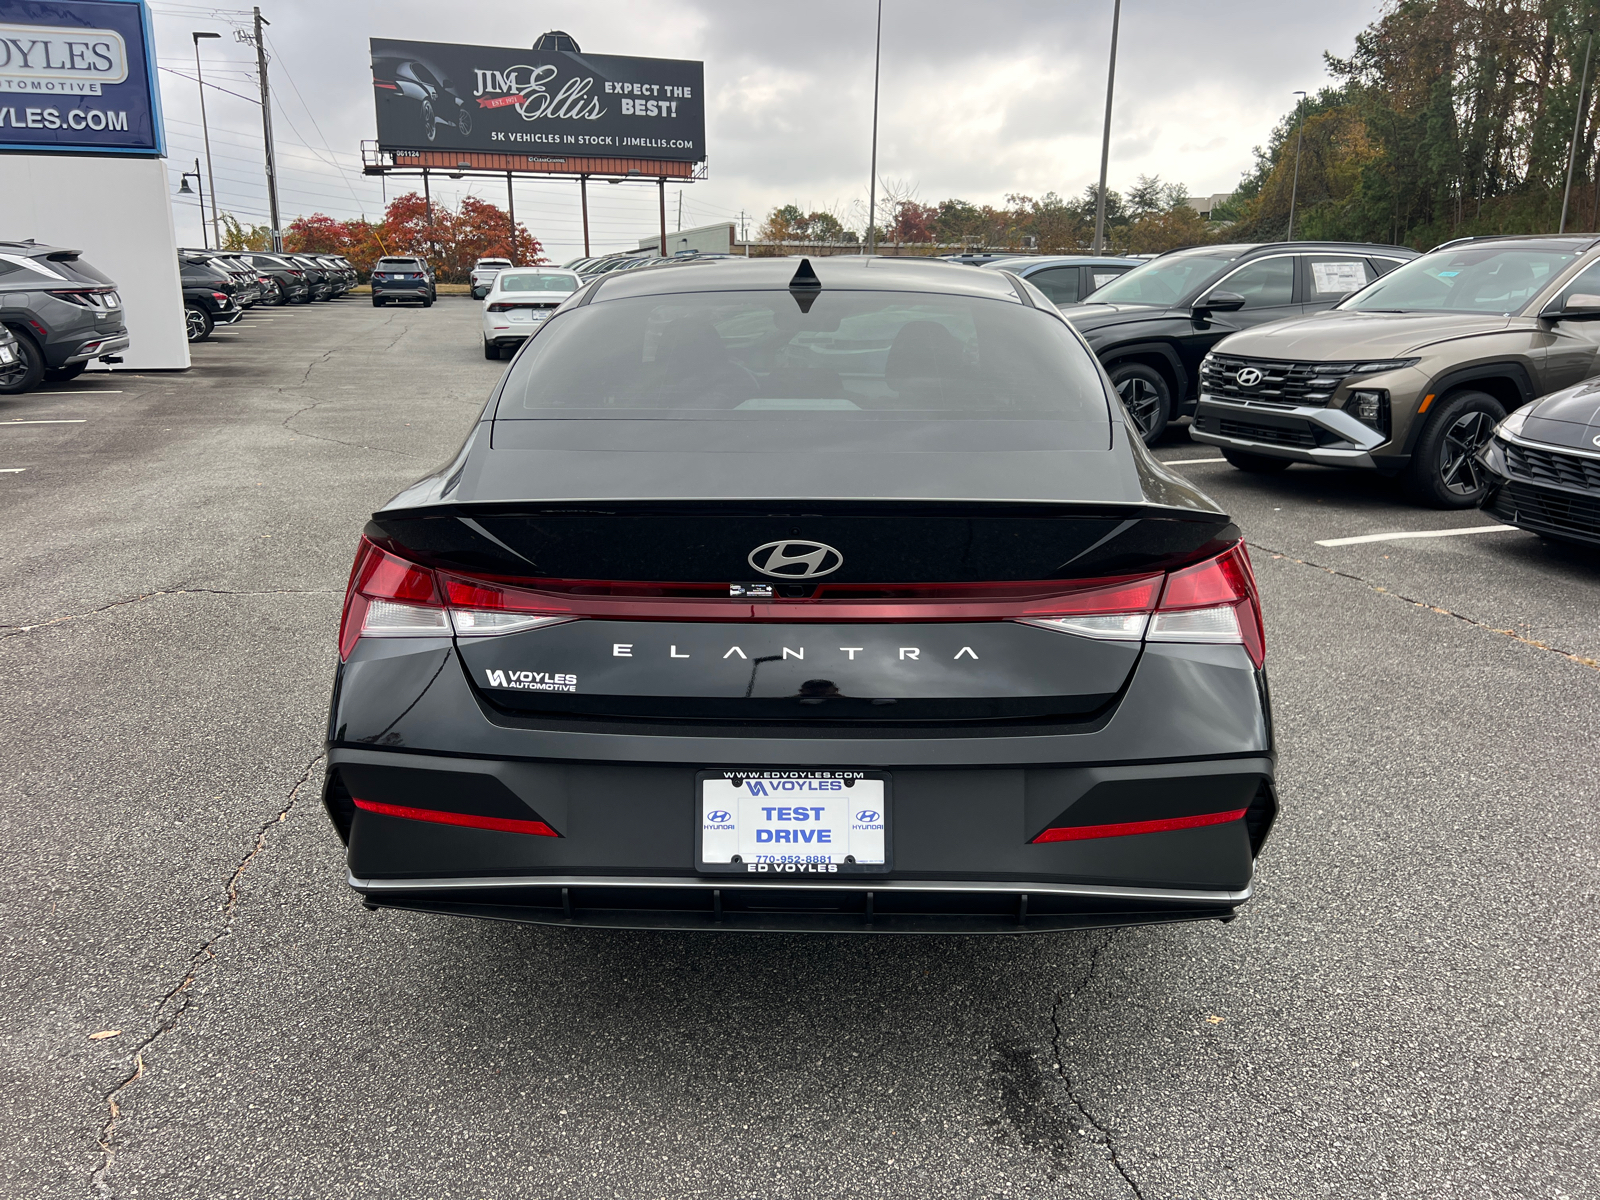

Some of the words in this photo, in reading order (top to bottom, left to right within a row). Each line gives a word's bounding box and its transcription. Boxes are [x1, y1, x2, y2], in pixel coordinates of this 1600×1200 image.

[0, 79, 98, 92] TOMOTIVE
[473, 69, 519, 96] JIM
[503, 64, 608, 121] Ellis
[604, 82, 660, 96] EXPECT
[664, 85, 692, 98] THE
[491, 99, 505, 107] EST.
[621, 99, 677, 117] BEST!
[491, 131, 505, 141] 5K
[508, 132, 560, 143] VEHICLES
[563, 135, 575, 144] IN
[578, 135, 613, 146] STOCK
[622, 137, 693, 149] JIMELLIS.COM
[612, 643, 979, 661] ELANTRA
[508, 670, 577, 685] VOYLES
[508, 681, 577, 692] AUTOMOTIVE
[769, 781, 842, 791] VOYLES
[761, 807, 825, 821] TEST
[756, 829, 832, 843] DRIVE
[756, 855, 832, 864] 770-952-8881
[747, 864, 769, 873] ED
[773, 864, 838, 873] VOYLES
